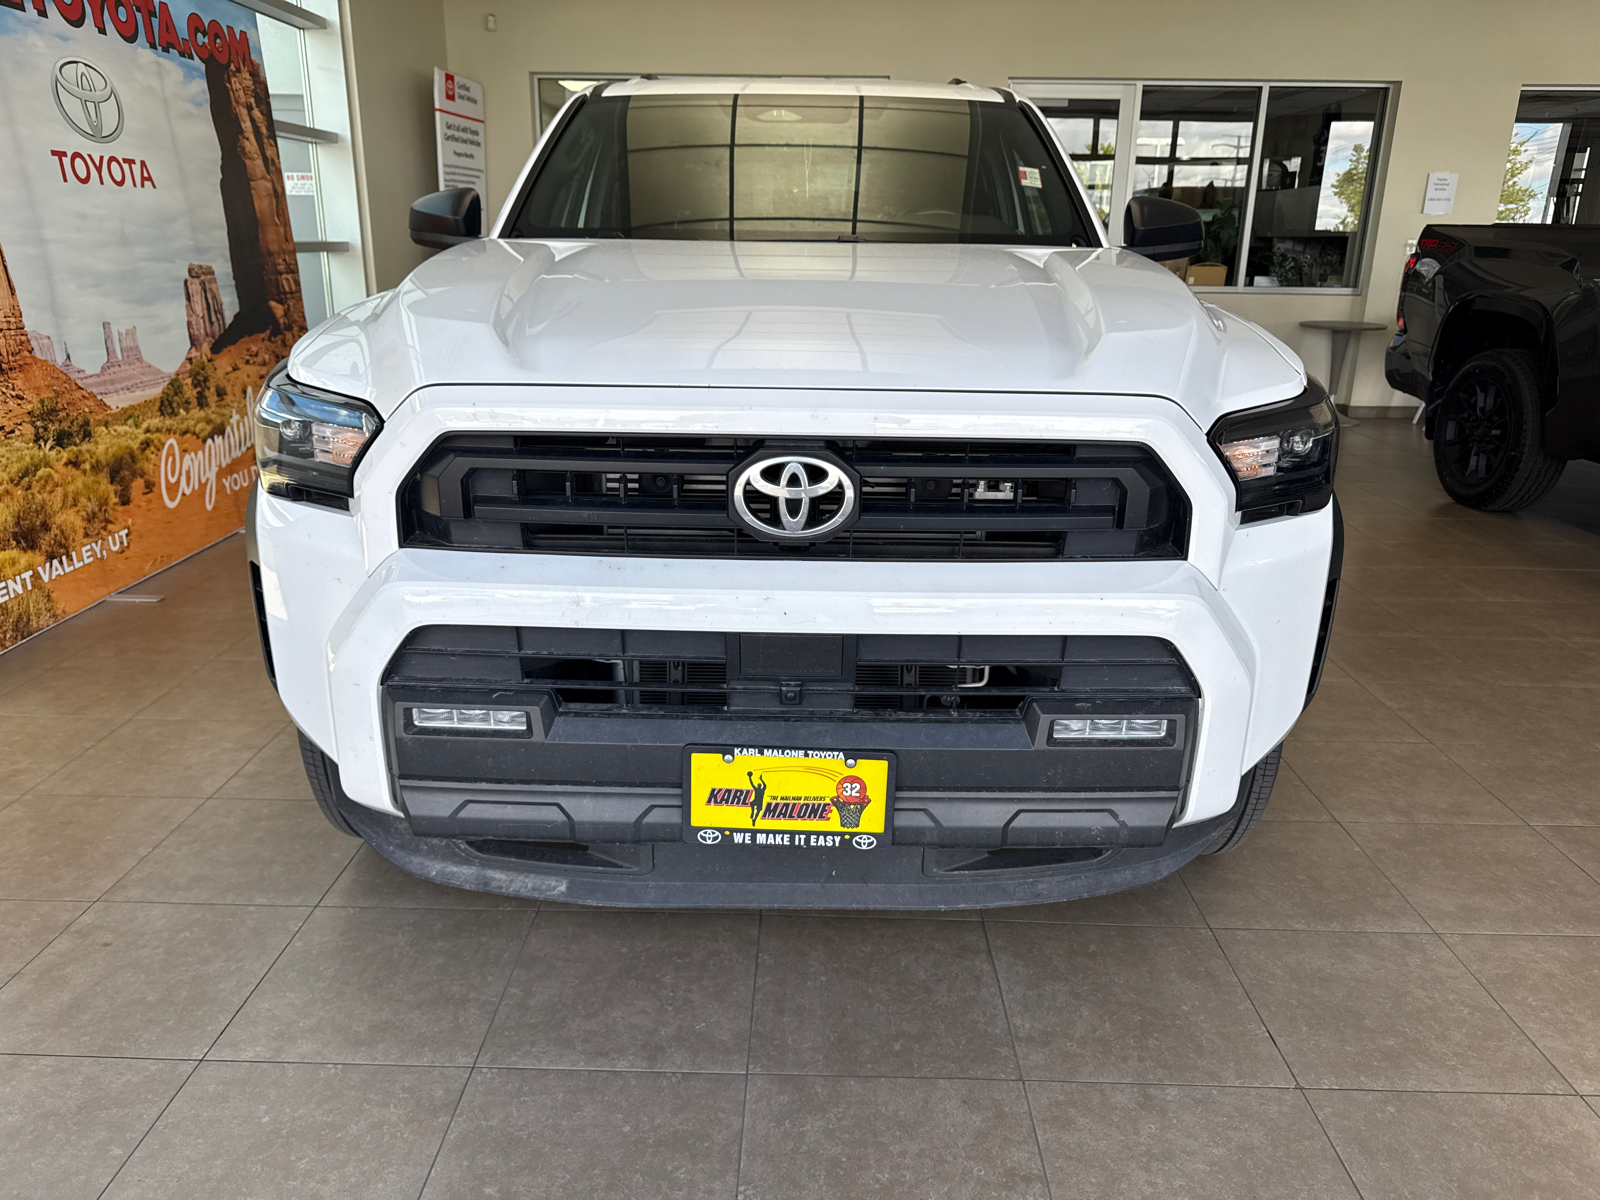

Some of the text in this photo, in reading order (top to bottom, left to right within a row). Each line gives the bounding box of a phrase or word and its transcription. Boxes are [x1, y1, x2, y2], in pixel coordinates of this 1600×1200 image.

[50, 149, 157, 189] TOYOTA
[222, 469, 249, 494] YOU
[0, 528, 129, 604] ENT VALLEY, UT
[734, 747, 845, 760] KARL MALONE TOYOTA
[705, 787, 754, 808] KARL
[842, 782, 861, 797] 32
[760, 801, 833, 821] MALONE
[733, 832, 841, 847] WE MAKE IT EASY
